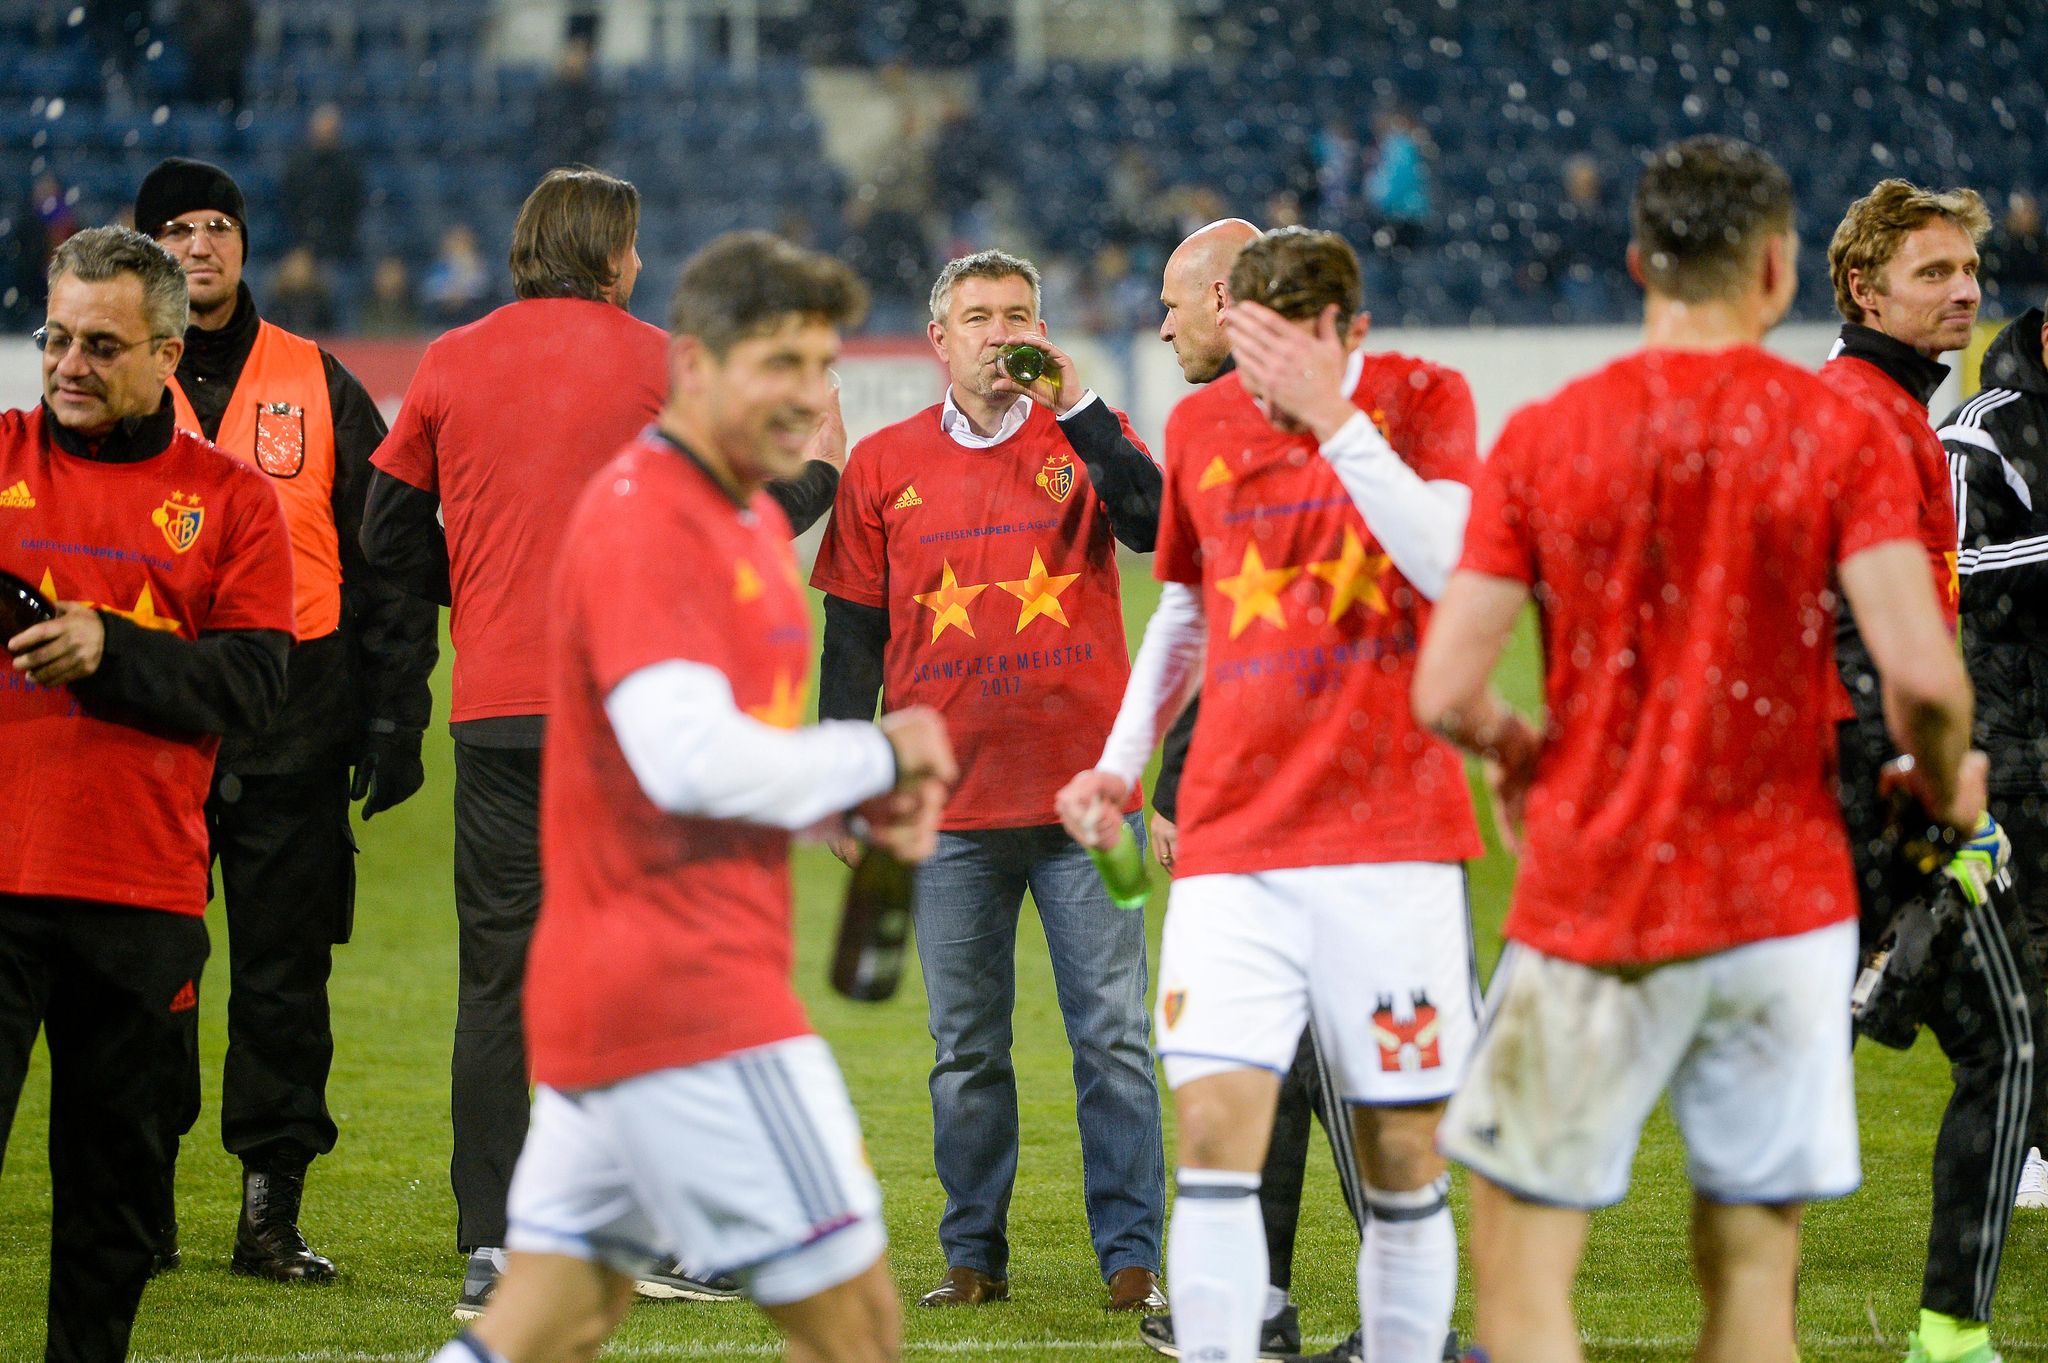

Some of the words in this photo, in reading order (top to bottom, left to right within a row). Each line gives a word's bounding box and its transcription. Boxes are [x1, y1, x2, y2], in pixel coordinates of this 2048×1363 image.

[0, 496, 36, 508] didas
[894, 496, 923, 510] adidas
[914, 655, 1008, 683] SCHWEIZER
[1017, 643, 1092, 671] MEISTER
[980, 676, 1022, 697] 2017
